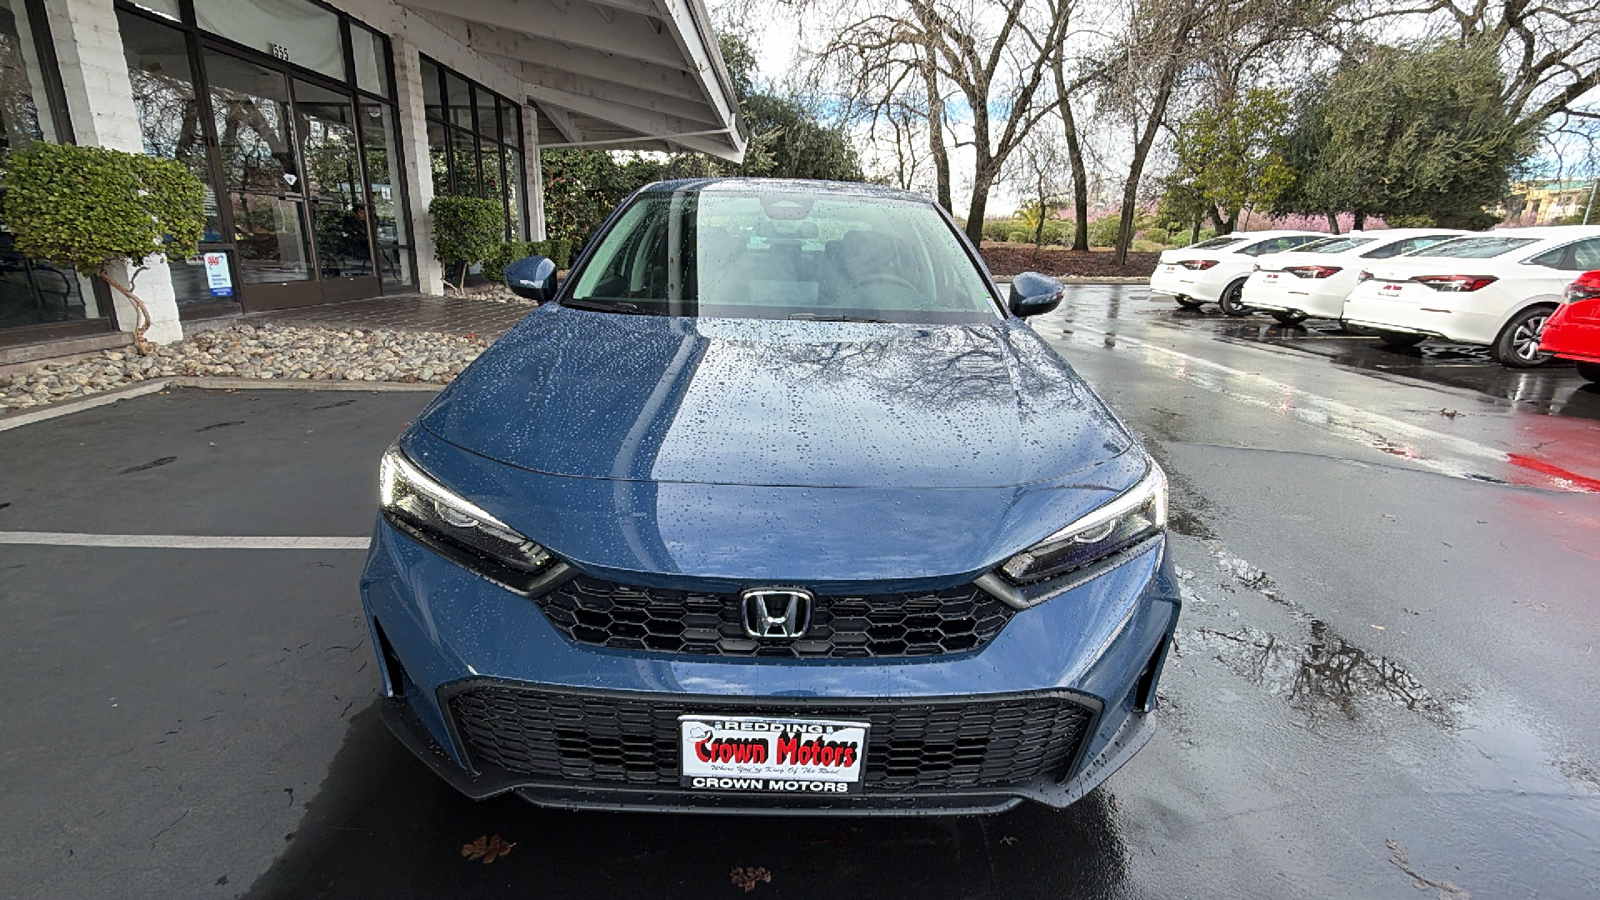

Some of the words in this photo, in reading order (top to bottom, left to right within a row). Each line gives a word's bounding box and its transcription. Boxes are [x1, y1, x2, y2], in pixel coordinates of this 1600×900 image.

[272, 43, 289, 61] 555
[725, 721, 823, 734] REDDING
[695, 737, 769, 764] Crown
[776, 732, 858, 768] Motors
[711, 764, 734, 772] Where
[765, 766, 784, 774] King
[788, 767, 799, 775] Of
[692, 777, 763, 789] CROWN
[768, 780, 848, 792] MOTORS
